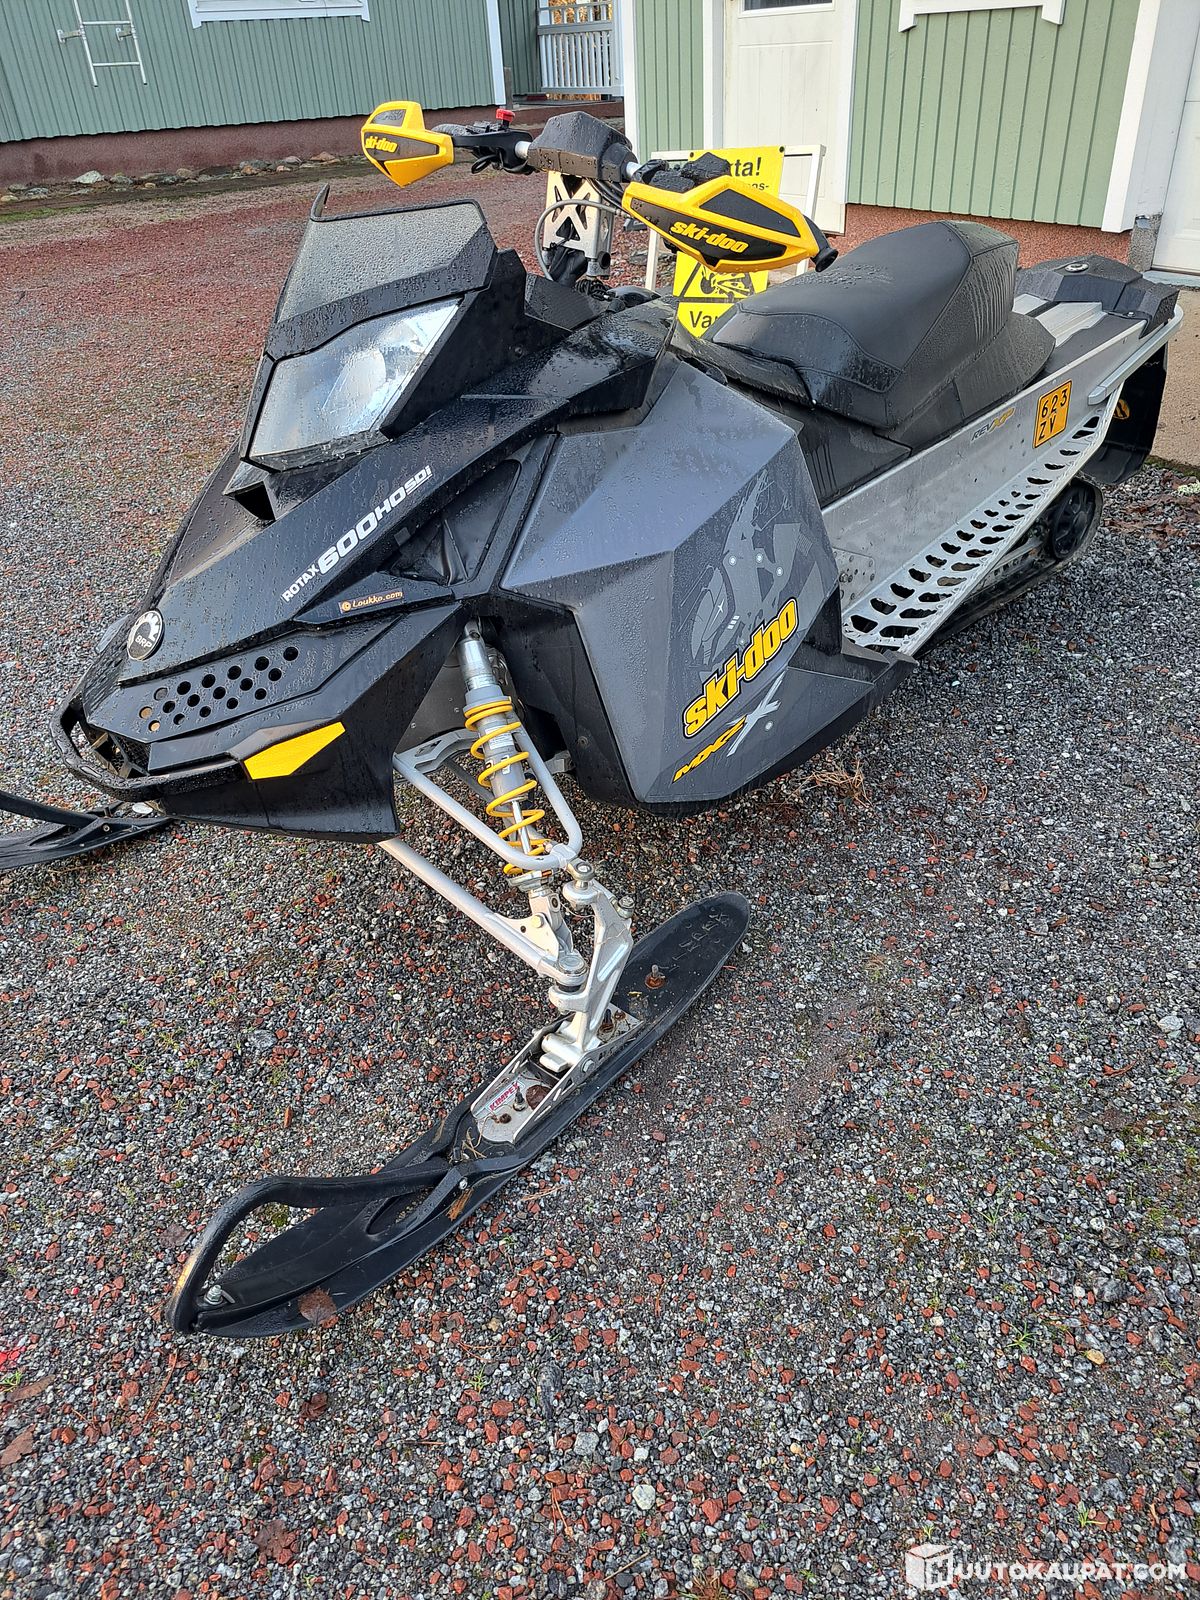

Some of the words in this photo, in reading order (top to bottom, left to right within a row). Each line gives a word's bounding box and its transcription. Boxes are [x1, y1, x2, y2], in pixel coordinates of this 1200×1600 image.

[364, 135, 398, 153] ski-doo
[730, 156, 762, 177] ta!
[670, 221, 749, 254] ski-doo
[689, 310, 719, 329] Va
[1041, 389, 1068, 418] 623
[1039, 415, 1056, 440] ZV
[282, 563, 320, 602] ROTAX
[352, 590, 403, 608] Loukko.com
[135, 635, 153, 648] BRP
[684, 598, 798, 737] ski-doo
[489, 1081, 521, 1111] KIMPEX
